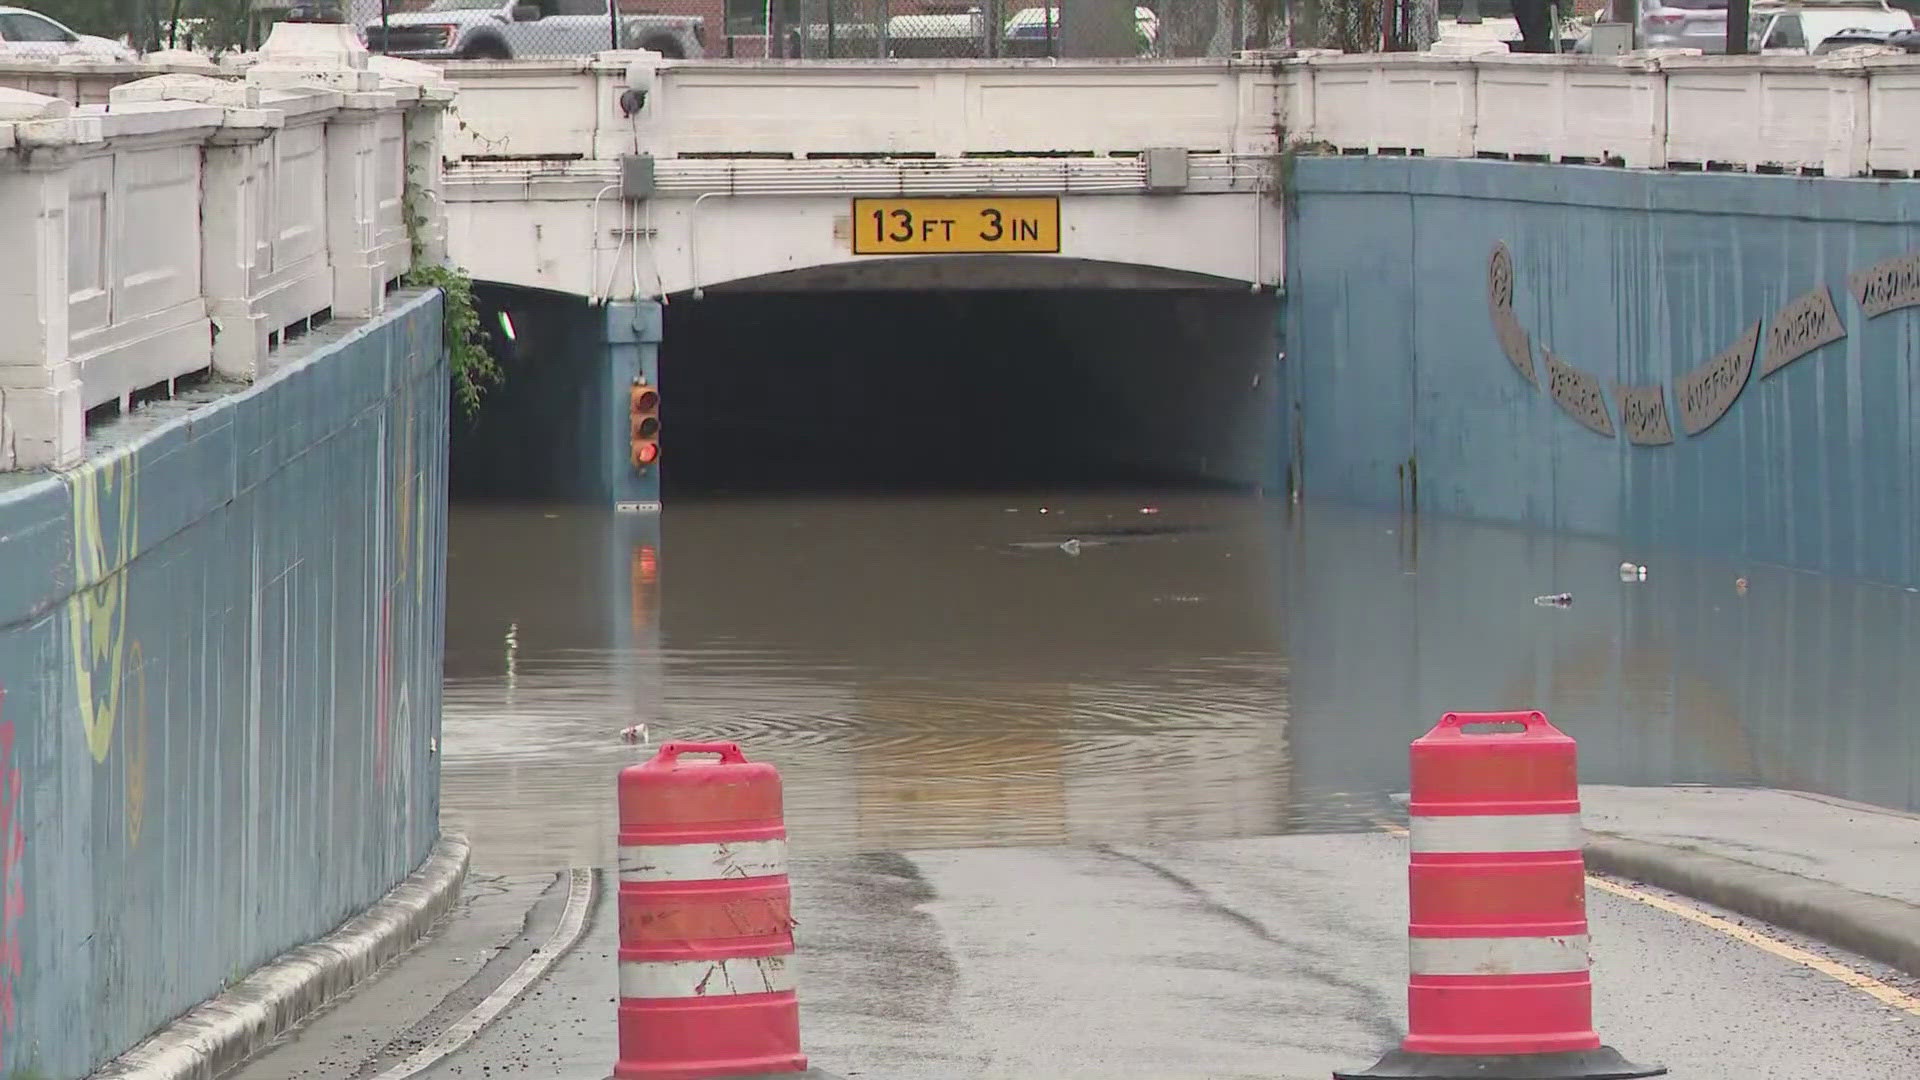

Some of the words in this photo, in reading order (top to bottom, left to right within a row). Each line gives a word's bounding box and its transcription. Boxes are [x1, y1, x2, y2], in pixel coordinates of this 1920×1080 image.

[873, 208, 914, 242] 13
[922, 219, 956, 242] FT
[979, 207, 1004, 242] 3
[1012, 218, 1039, 242] IN
